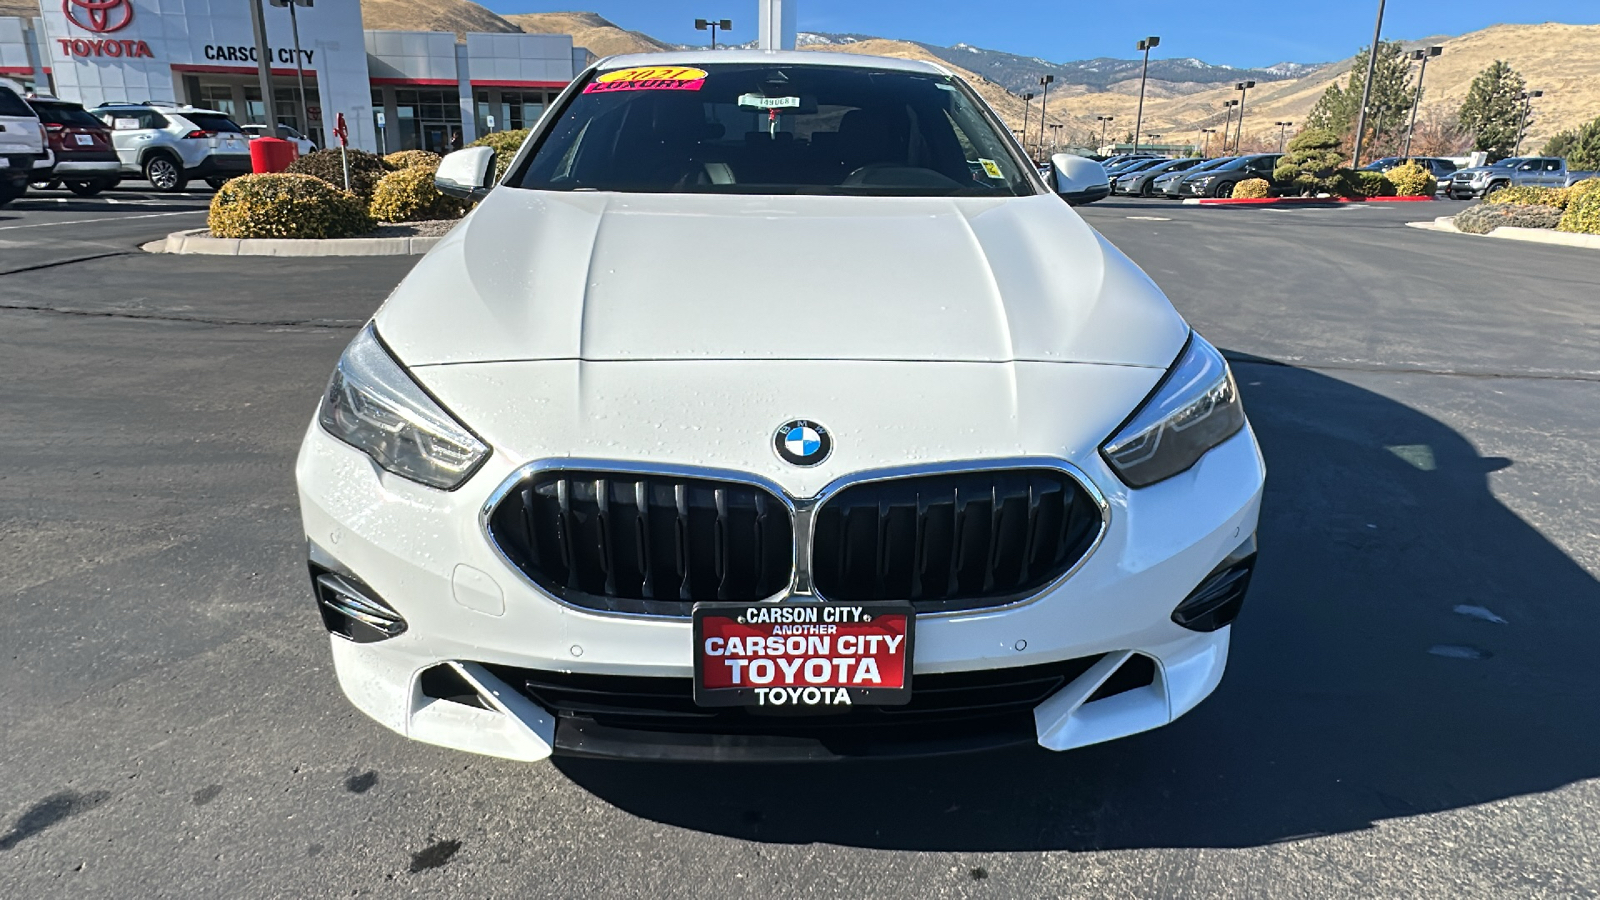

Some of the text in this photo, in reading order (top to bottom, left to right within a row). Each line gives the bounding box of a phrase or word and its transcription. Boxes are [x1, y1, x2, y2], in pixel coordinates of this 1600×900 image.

[57, 39, 154, 58] TOYOTA
[613, 69, 690, 82] 2021
[591, 79, 693, 91] LUXURY
[779, 420, 827, 435] BMW
[746, 606, 863, 623] CARSON CITY
[772, 624, 838, 635] ANOTHER
[704, 634, 904, 656] CARSON CITY
[724, 657, 882, 684] TOYOTA
[754, 687, 852, 706] TOYOTA
